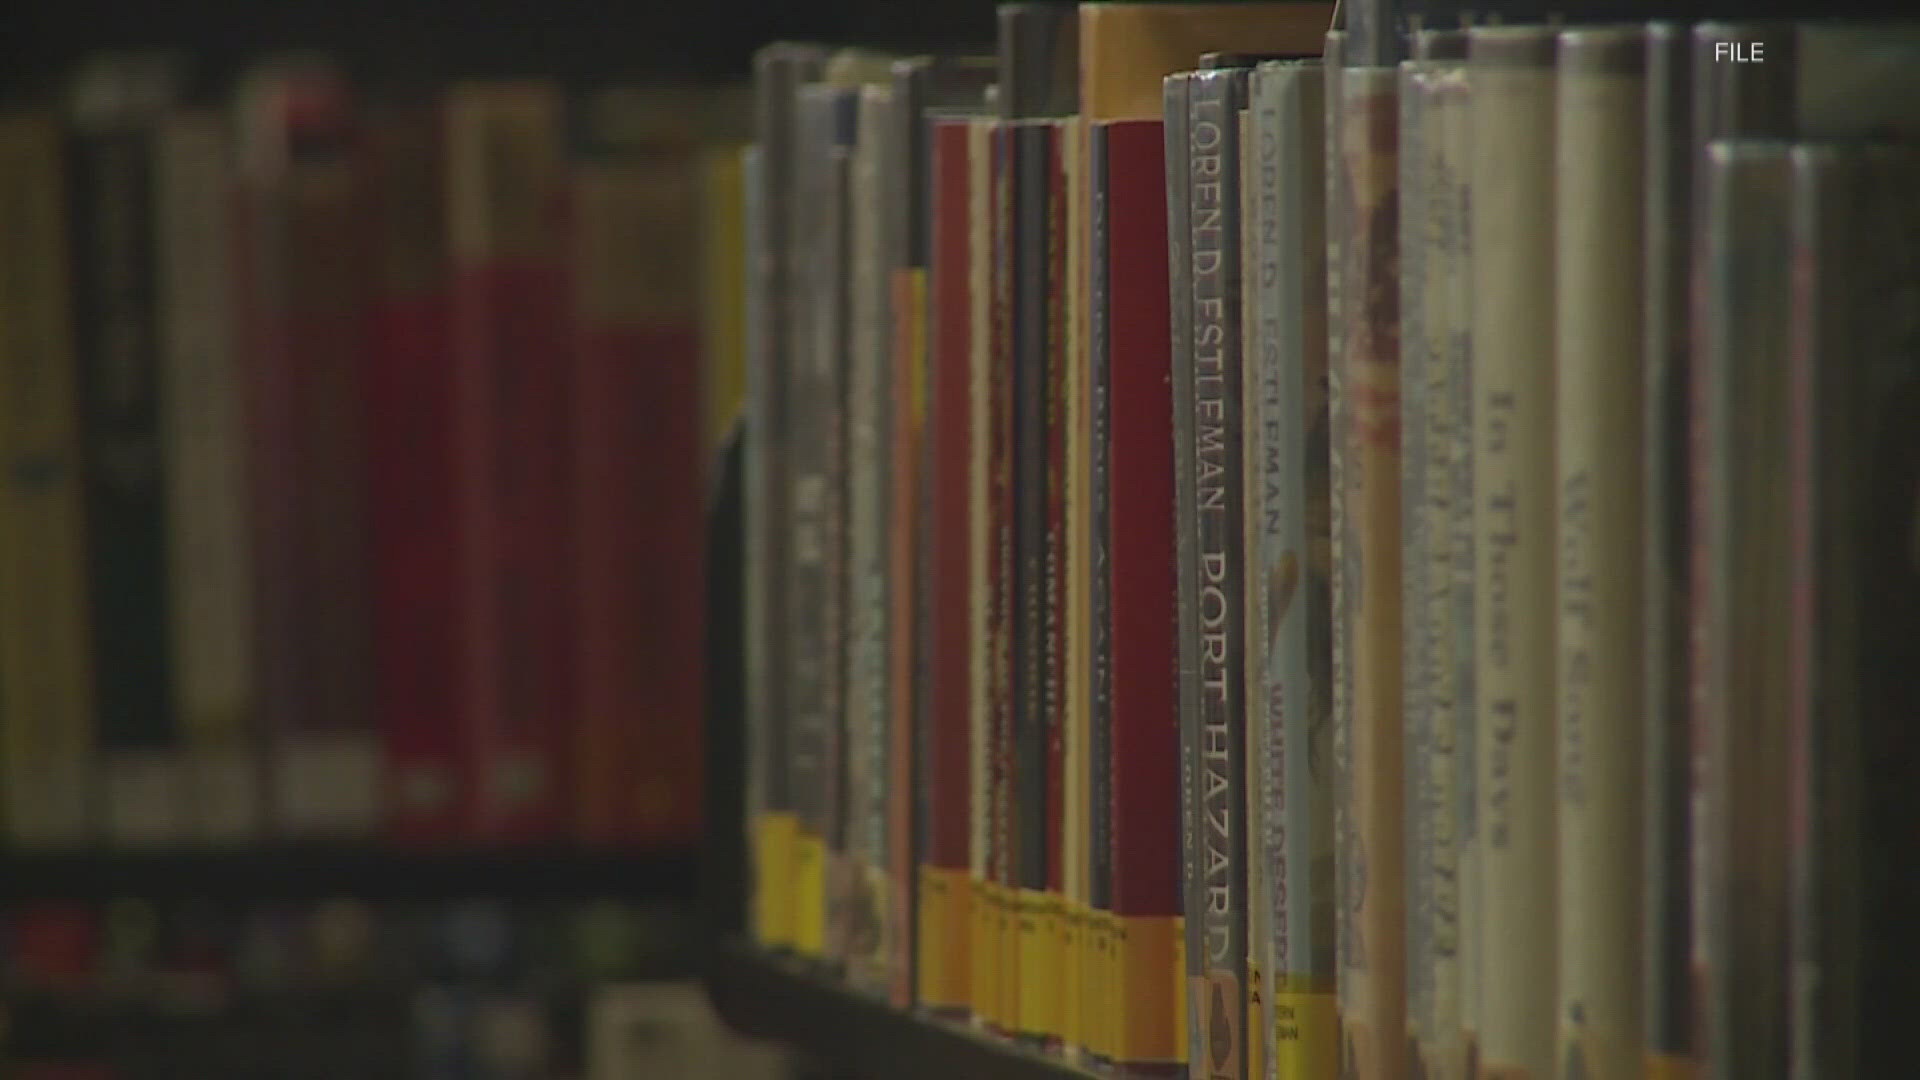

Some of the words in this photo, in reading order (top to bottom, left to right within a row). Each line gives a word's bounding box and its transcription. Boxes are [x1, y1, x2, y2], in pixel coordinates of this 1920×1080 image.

[1193, 97, 1222, 234] LOREN
[1263, 108, 1281, 245] LOREN
[1195, 296, 1225, 512] ESTLEMAN
[1265, 317, 1282, 536] ESTLEMAN
[1487, 392, 1516, 453] In
[1202, 550, 1228, 703] PORT
[1486, 482, 1517, 668] Those
[1563, 470, 1592, 631] Wolf
[1271, 682, 1286, 811] WHITE
[1486, 697, 1517, 850] Days
[1203, 722, 1230, 963] HAZARD
[1271, 825, 1289, 988] DESERT
